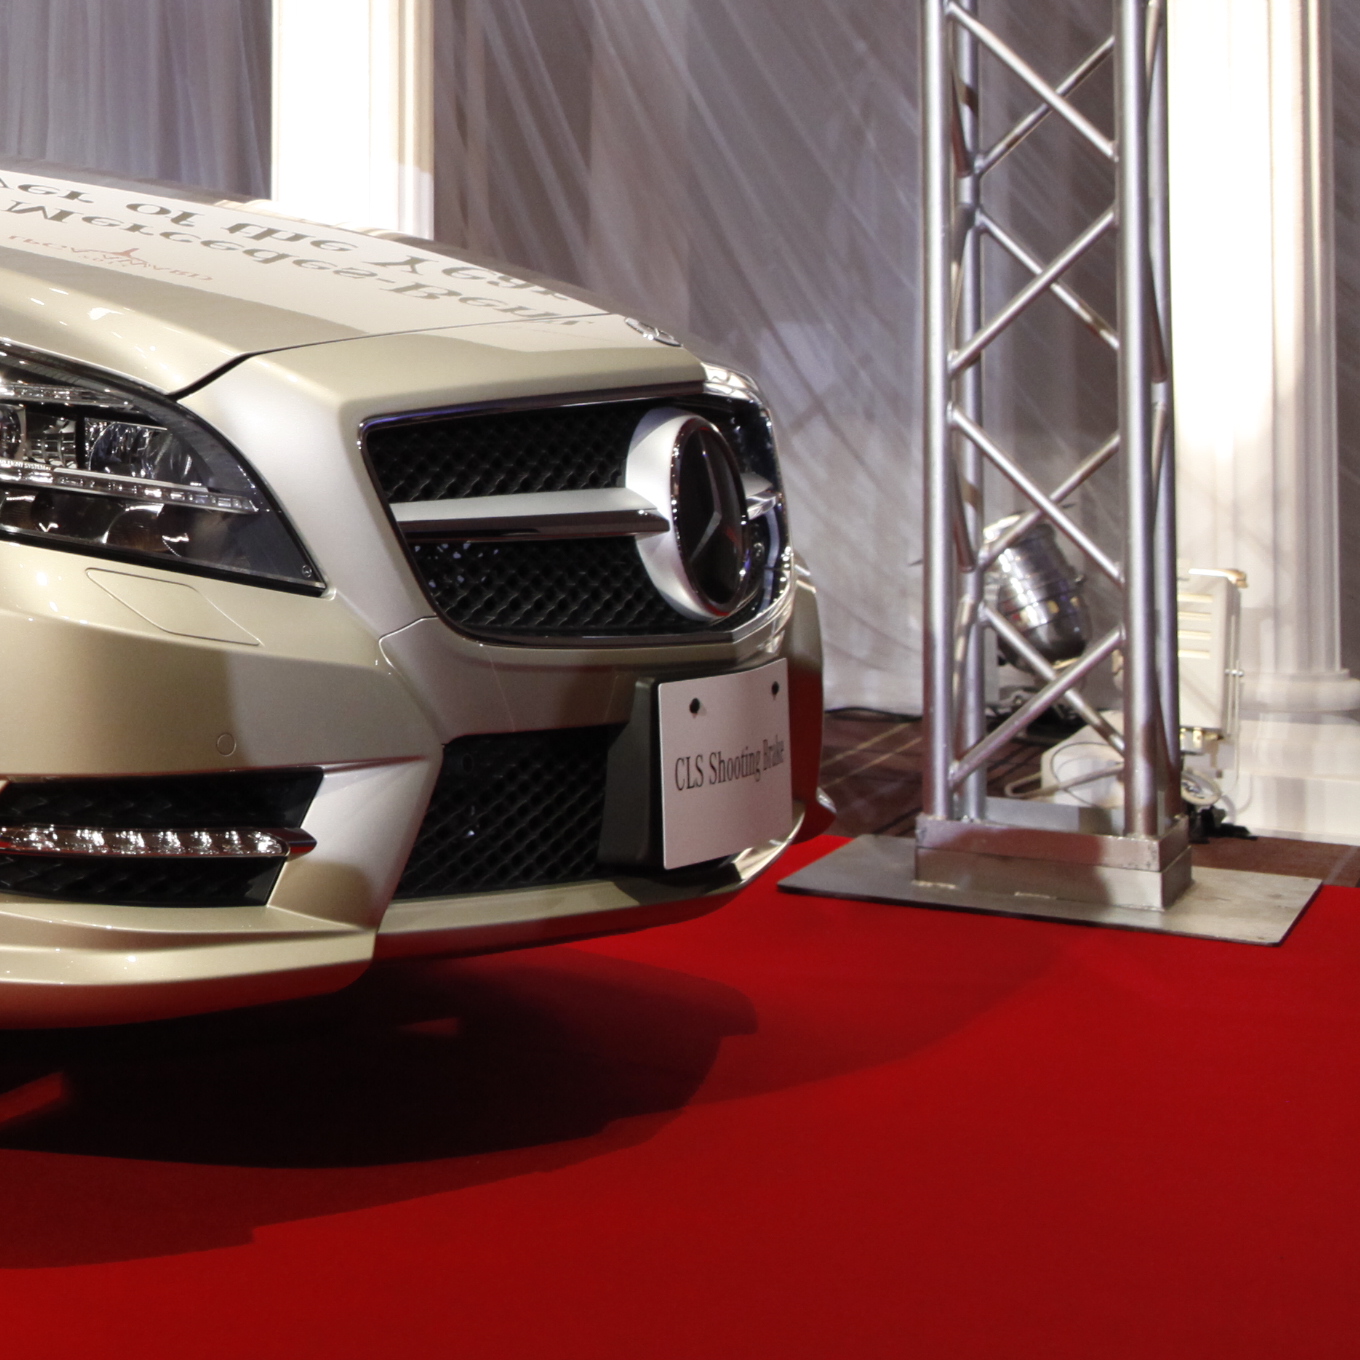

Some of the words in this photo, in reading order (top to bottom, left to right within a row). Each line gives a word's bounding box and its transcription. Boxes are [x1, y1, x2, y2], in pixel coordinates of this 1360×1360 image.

[674, 753, 705, 791] CLS
[708, 745, 762, 783] Shooting
[762, 736, 785, 772] Brake
